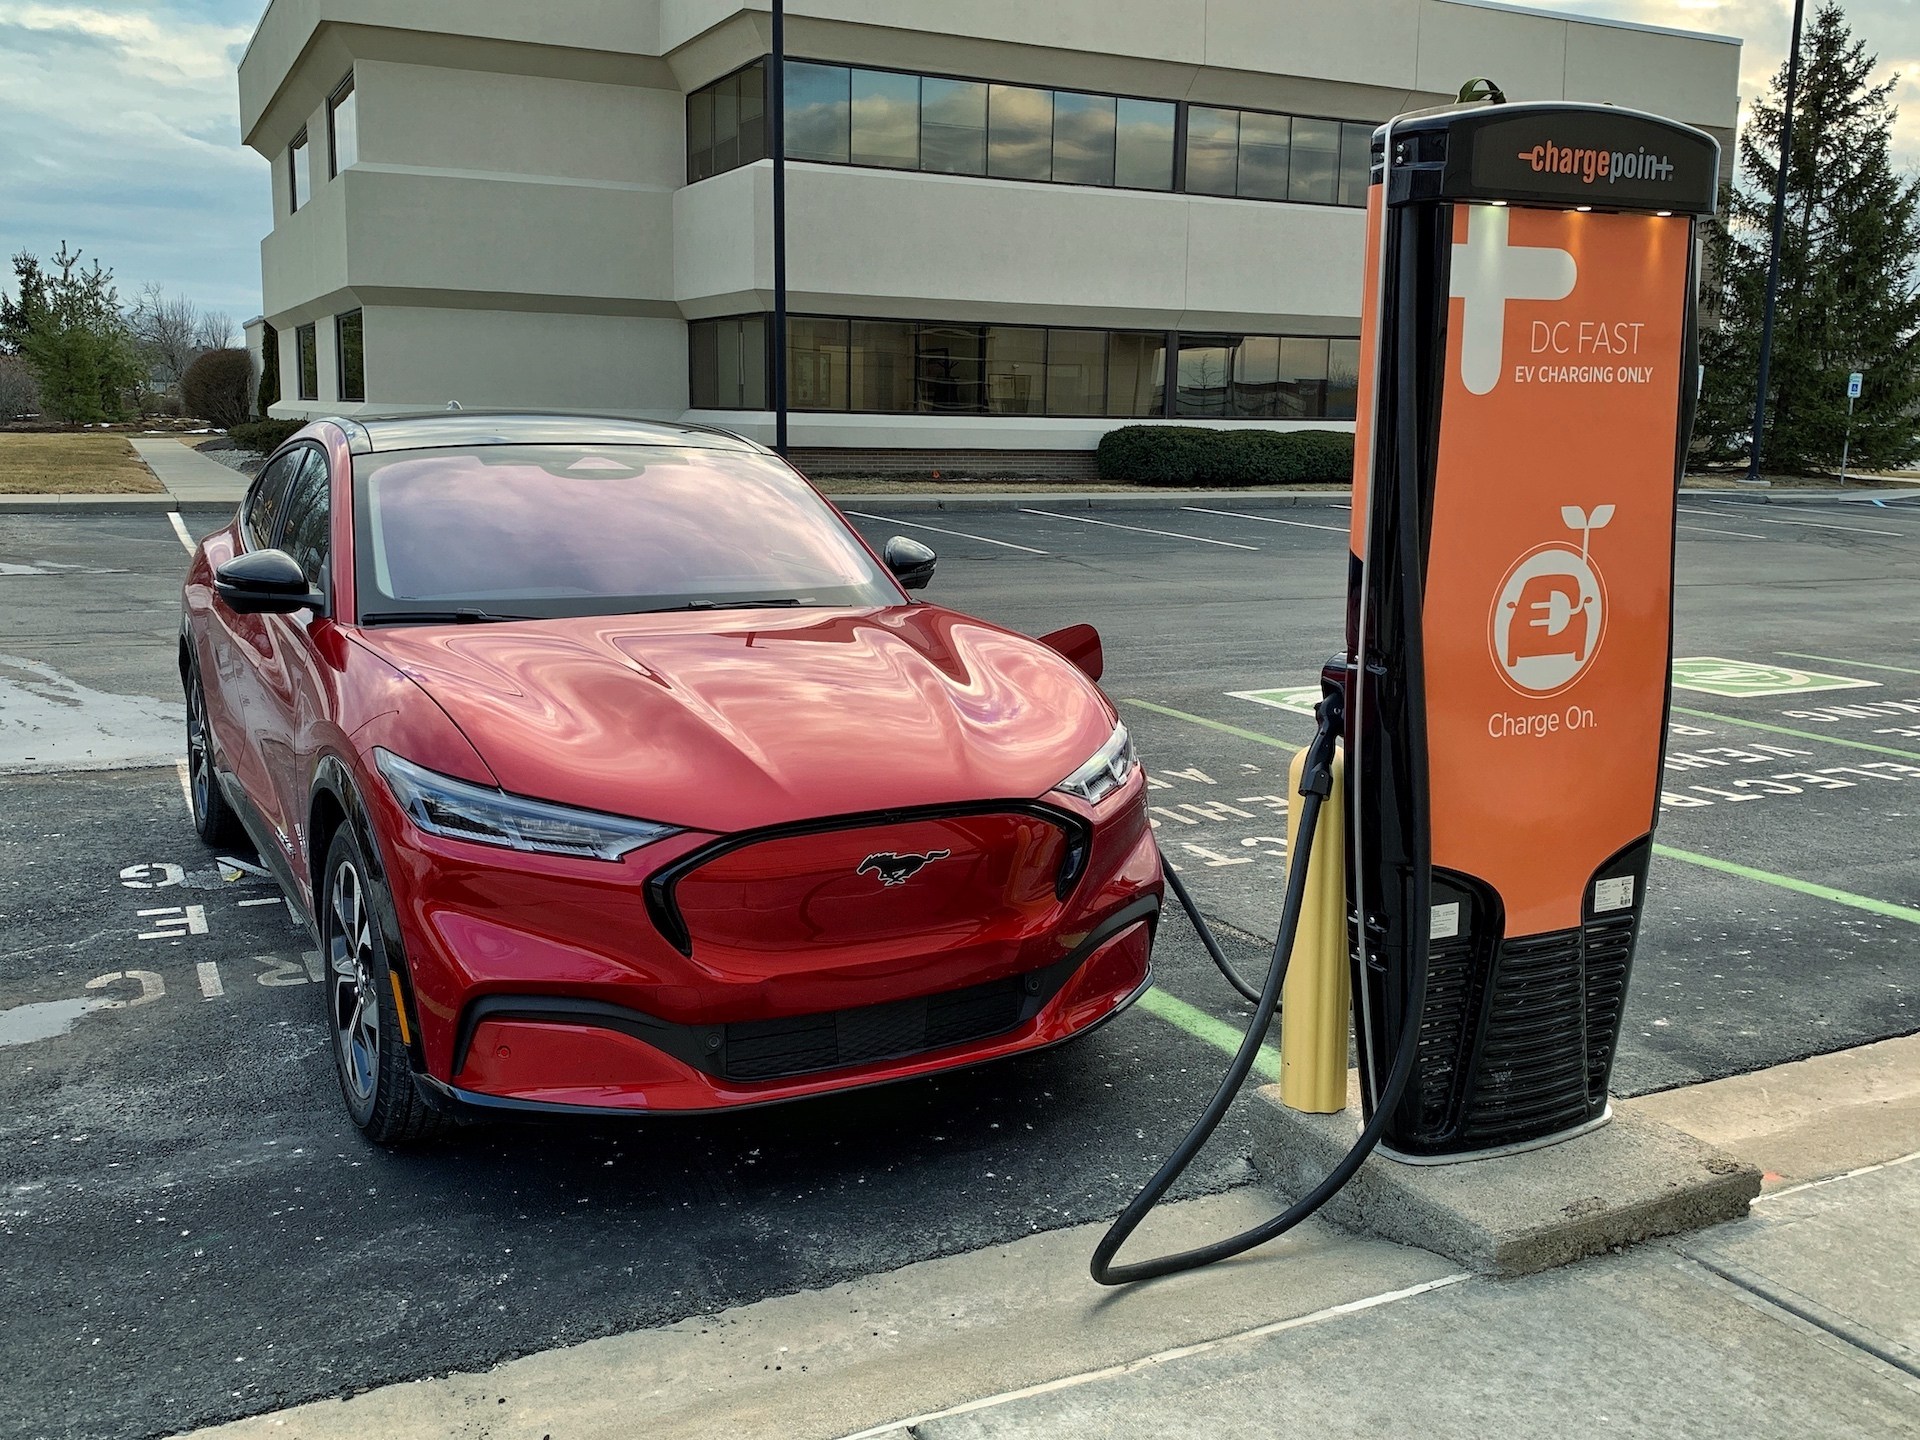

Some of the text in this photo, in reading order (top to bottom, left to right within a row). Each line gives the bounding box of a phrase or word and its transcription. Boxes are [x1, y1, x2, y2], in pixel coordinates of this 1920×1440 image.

[1517, 140, 1674, 184] chargepoint
[1531, 320, 1645, 354] DC FAST
[1515, 365, 1654, 384] EV CHARGING ONLY
[1488, 705, 1598, 738] Charge On.
